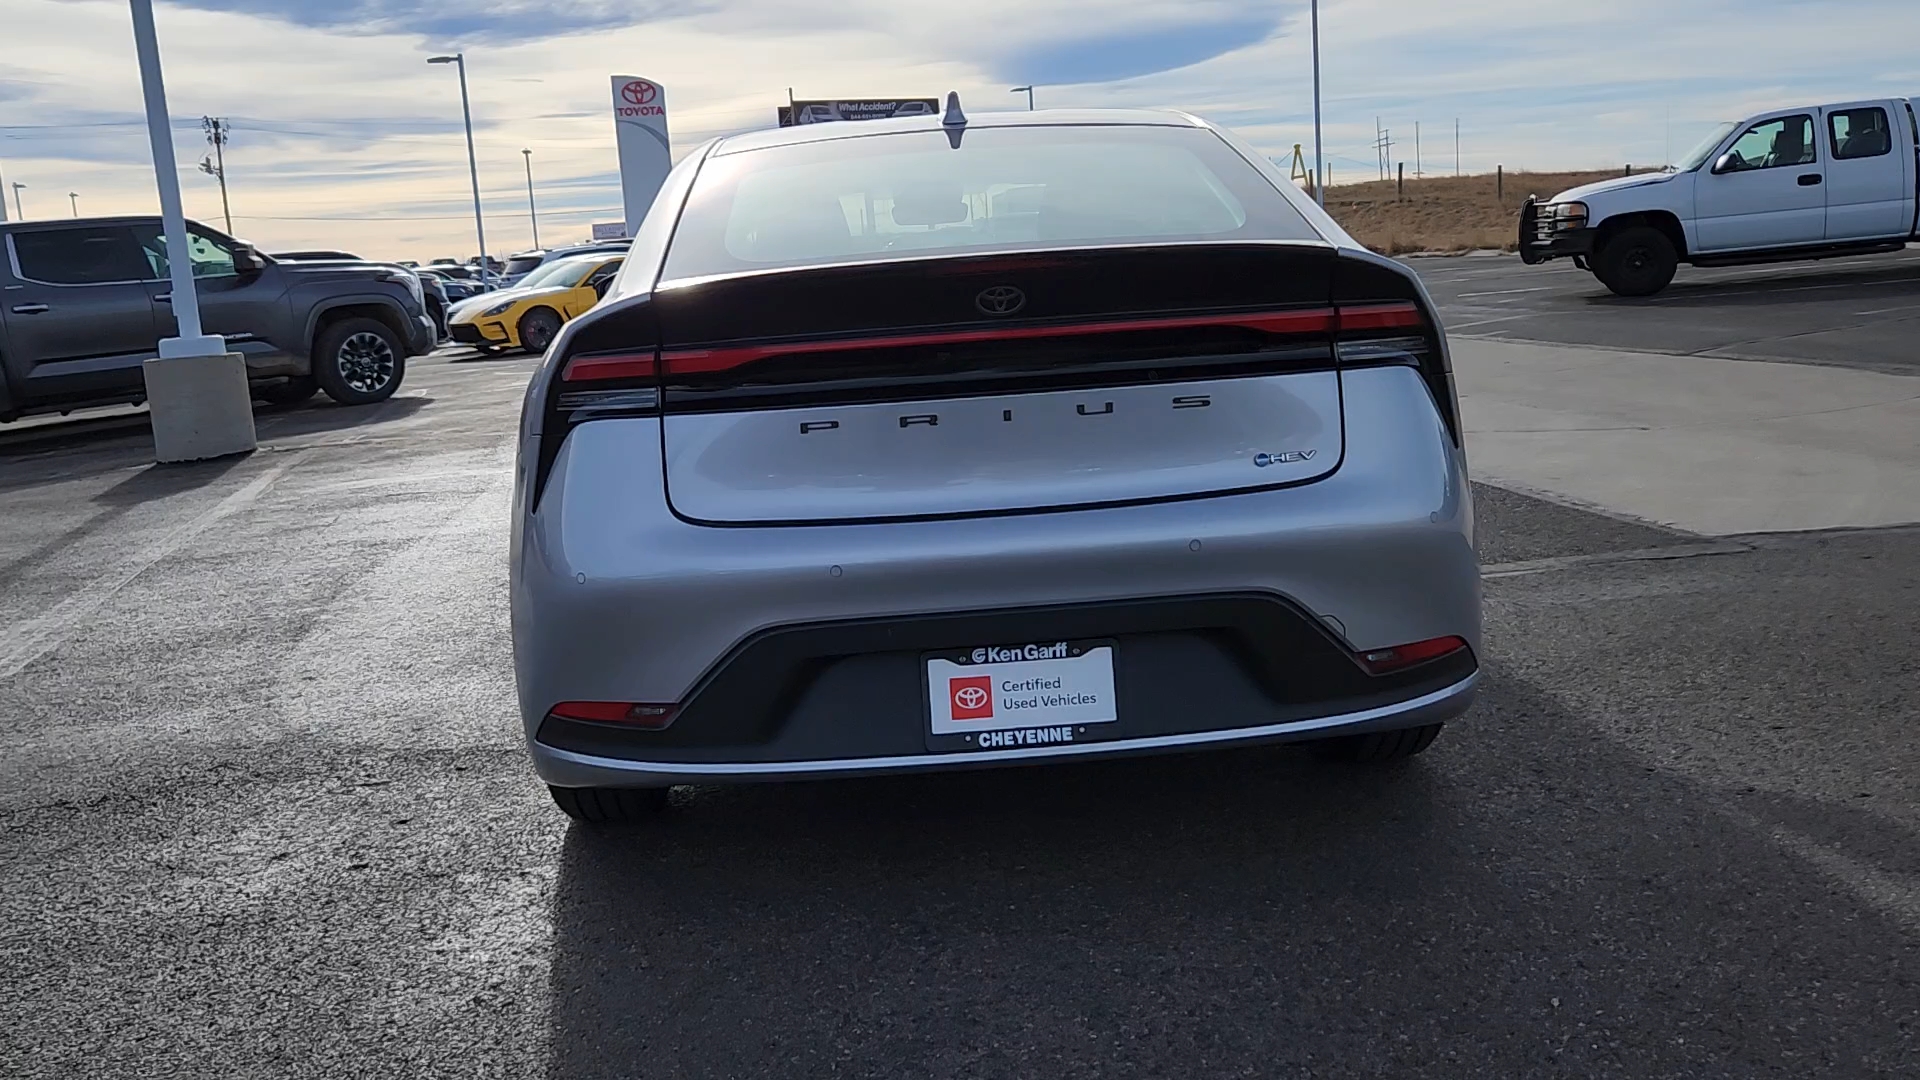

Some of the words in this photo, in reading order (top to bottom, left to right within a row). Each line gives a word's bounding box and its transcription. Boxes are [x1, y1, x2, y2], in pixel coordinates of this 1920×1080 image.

[617, 105, 665, 117] TOYOTA
[838, 102, 858, 111] What
[859, 101, 897, 111] Accident?
[800, 395, 1211, 434] PRIUS
[1268, 449, 1317, 464] HEV
[987, 646, 1022, 663] Ken
[1024, 642, 1068, 660] Garff
[1002, 676, 1062, 692] Certified
[1003, 695, 1038, 710] Used
[1041, 692, 1097, 707] Vehicles
[978, 726, 1073, 747] CHEYENNE
